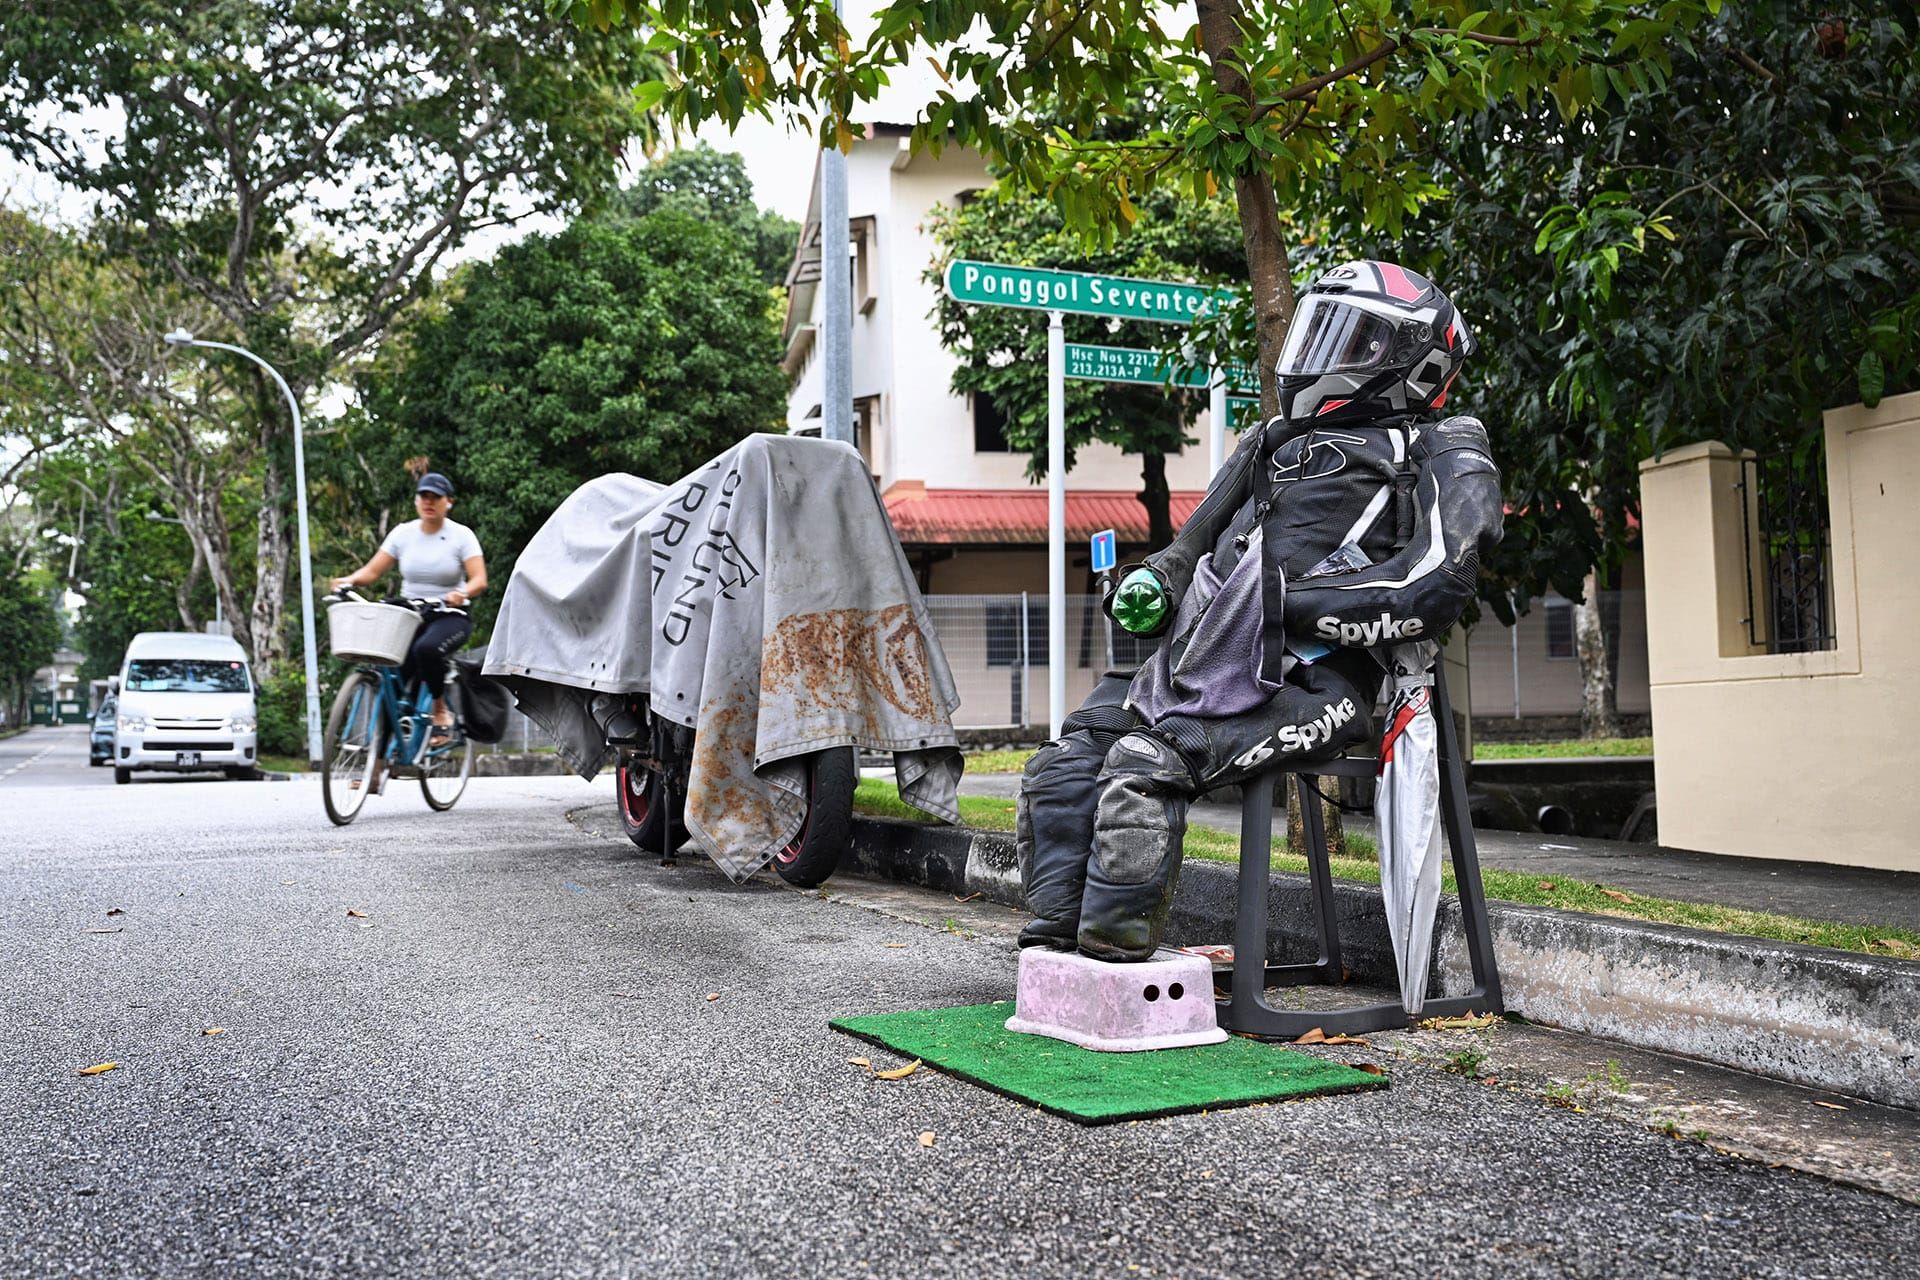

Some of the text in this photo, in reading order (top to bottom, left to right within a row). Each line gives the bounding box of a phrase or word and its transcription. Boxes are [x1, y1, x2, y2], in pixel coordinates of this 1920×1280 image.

[964, 266, 1078, 305] Ponggol
[1071, 347, 1094, 361] Hse
[1099, 350, 1123, 363] Nos
[1315, 613, 1424, 647] Spyke
[1278, 697, 1357, 752] Spyke
